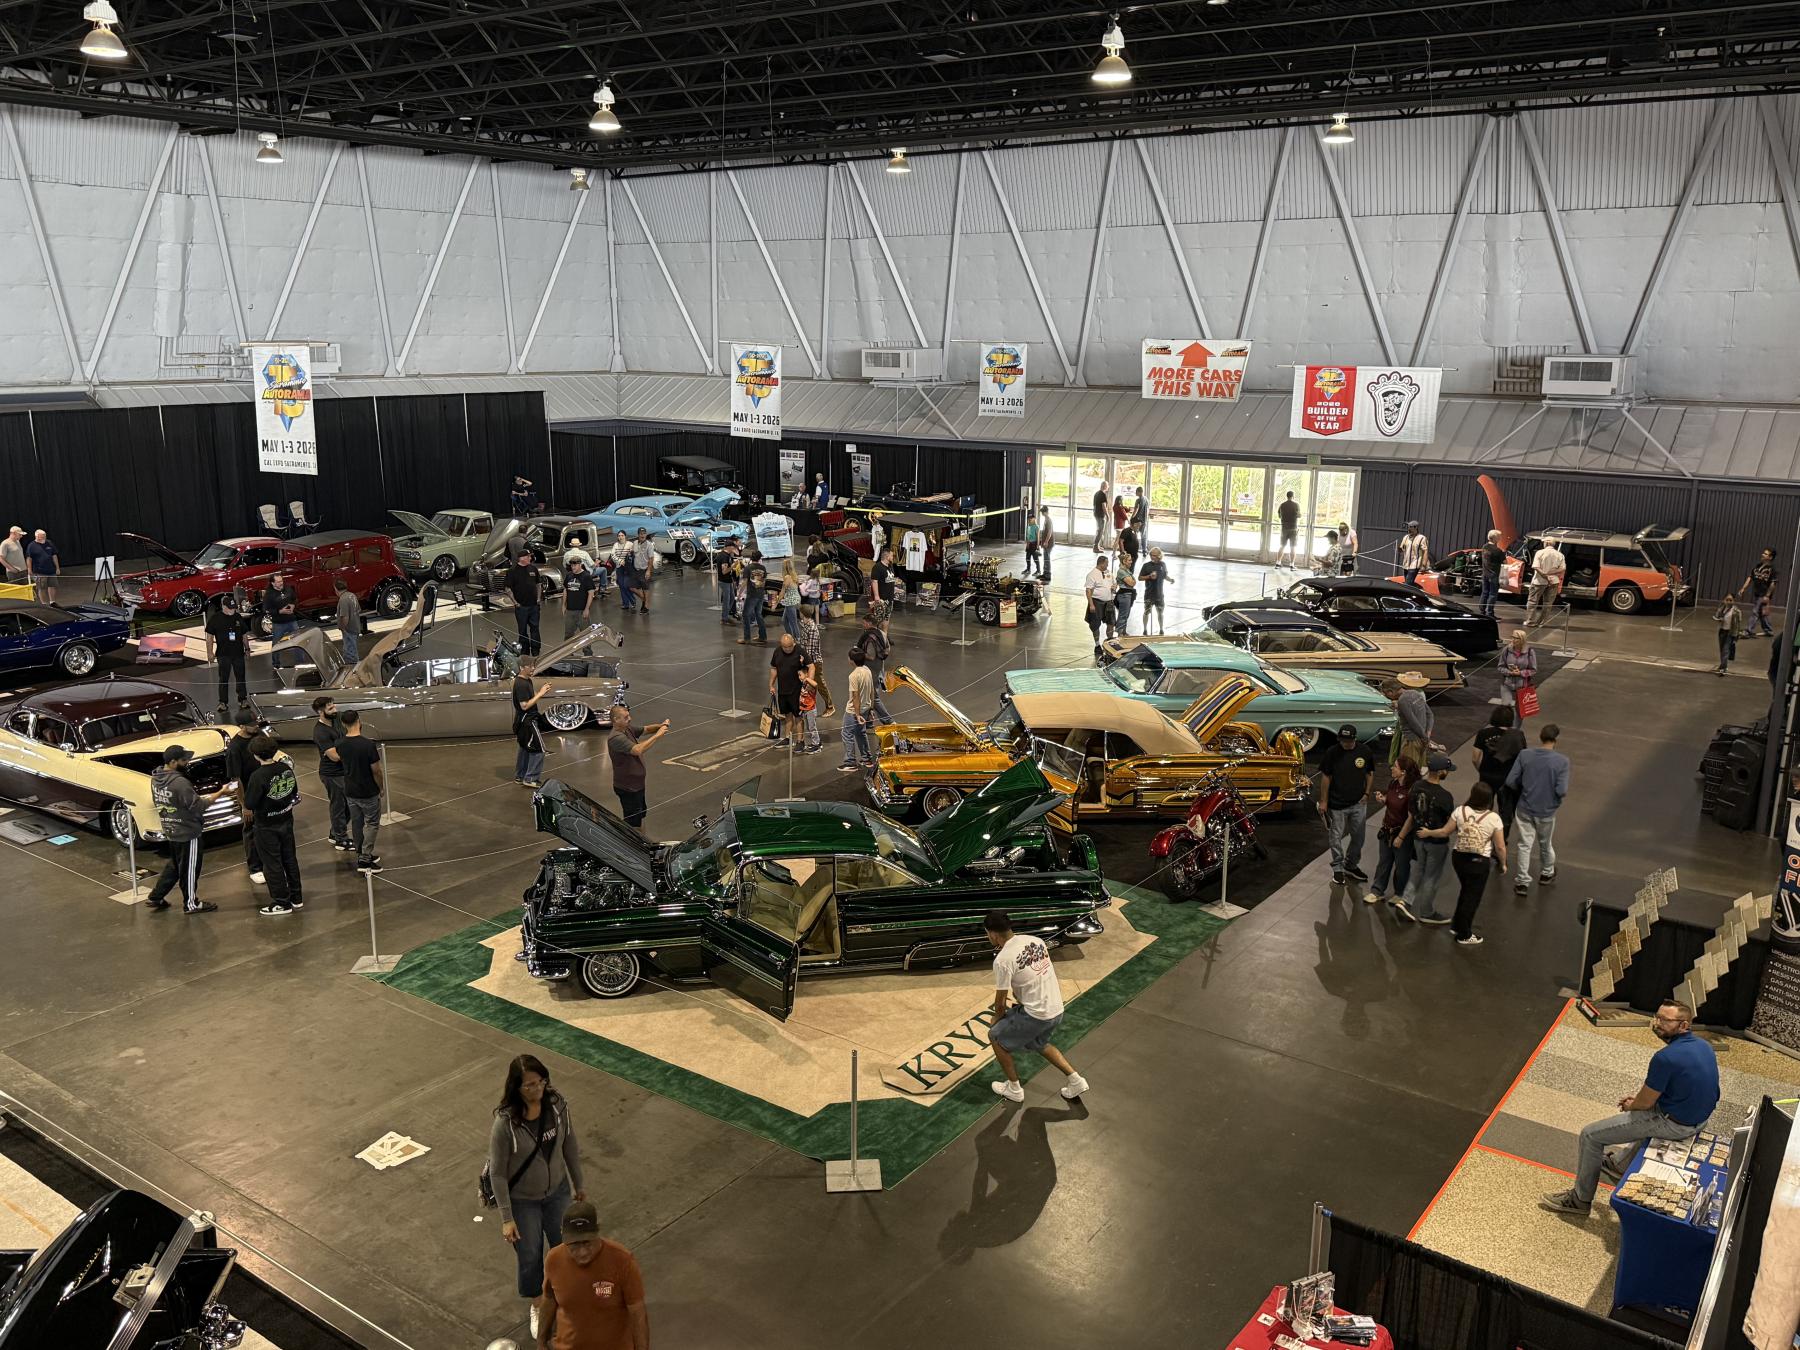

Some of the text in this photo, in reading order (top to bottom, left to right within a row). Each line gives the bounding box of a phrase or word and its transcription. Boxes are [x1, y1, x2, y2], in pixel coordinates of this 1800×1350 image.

[736, 376, 779, 386] AUTORAMA
[1147, 366, 1243, 382] MORE CARS
[262, 389, 312, 400] AUTORAMA
[1152, 380, 1236, 399] THIS WAY
[980, 397, 1024, 407] MAY 1-3 2026
[1307, 407, 1349, 416] BUILDER
[733, 412, 780, 426] MAY 1-3 2026
[1314, 421, 1340, 430] YEAR
[262, 439, 279, 453] MAY
[281, 441, 294, 454] 1-3
[1770, 977, 1799, 992] GAS AND
[897, 1003, 996, 1090] KRYP
